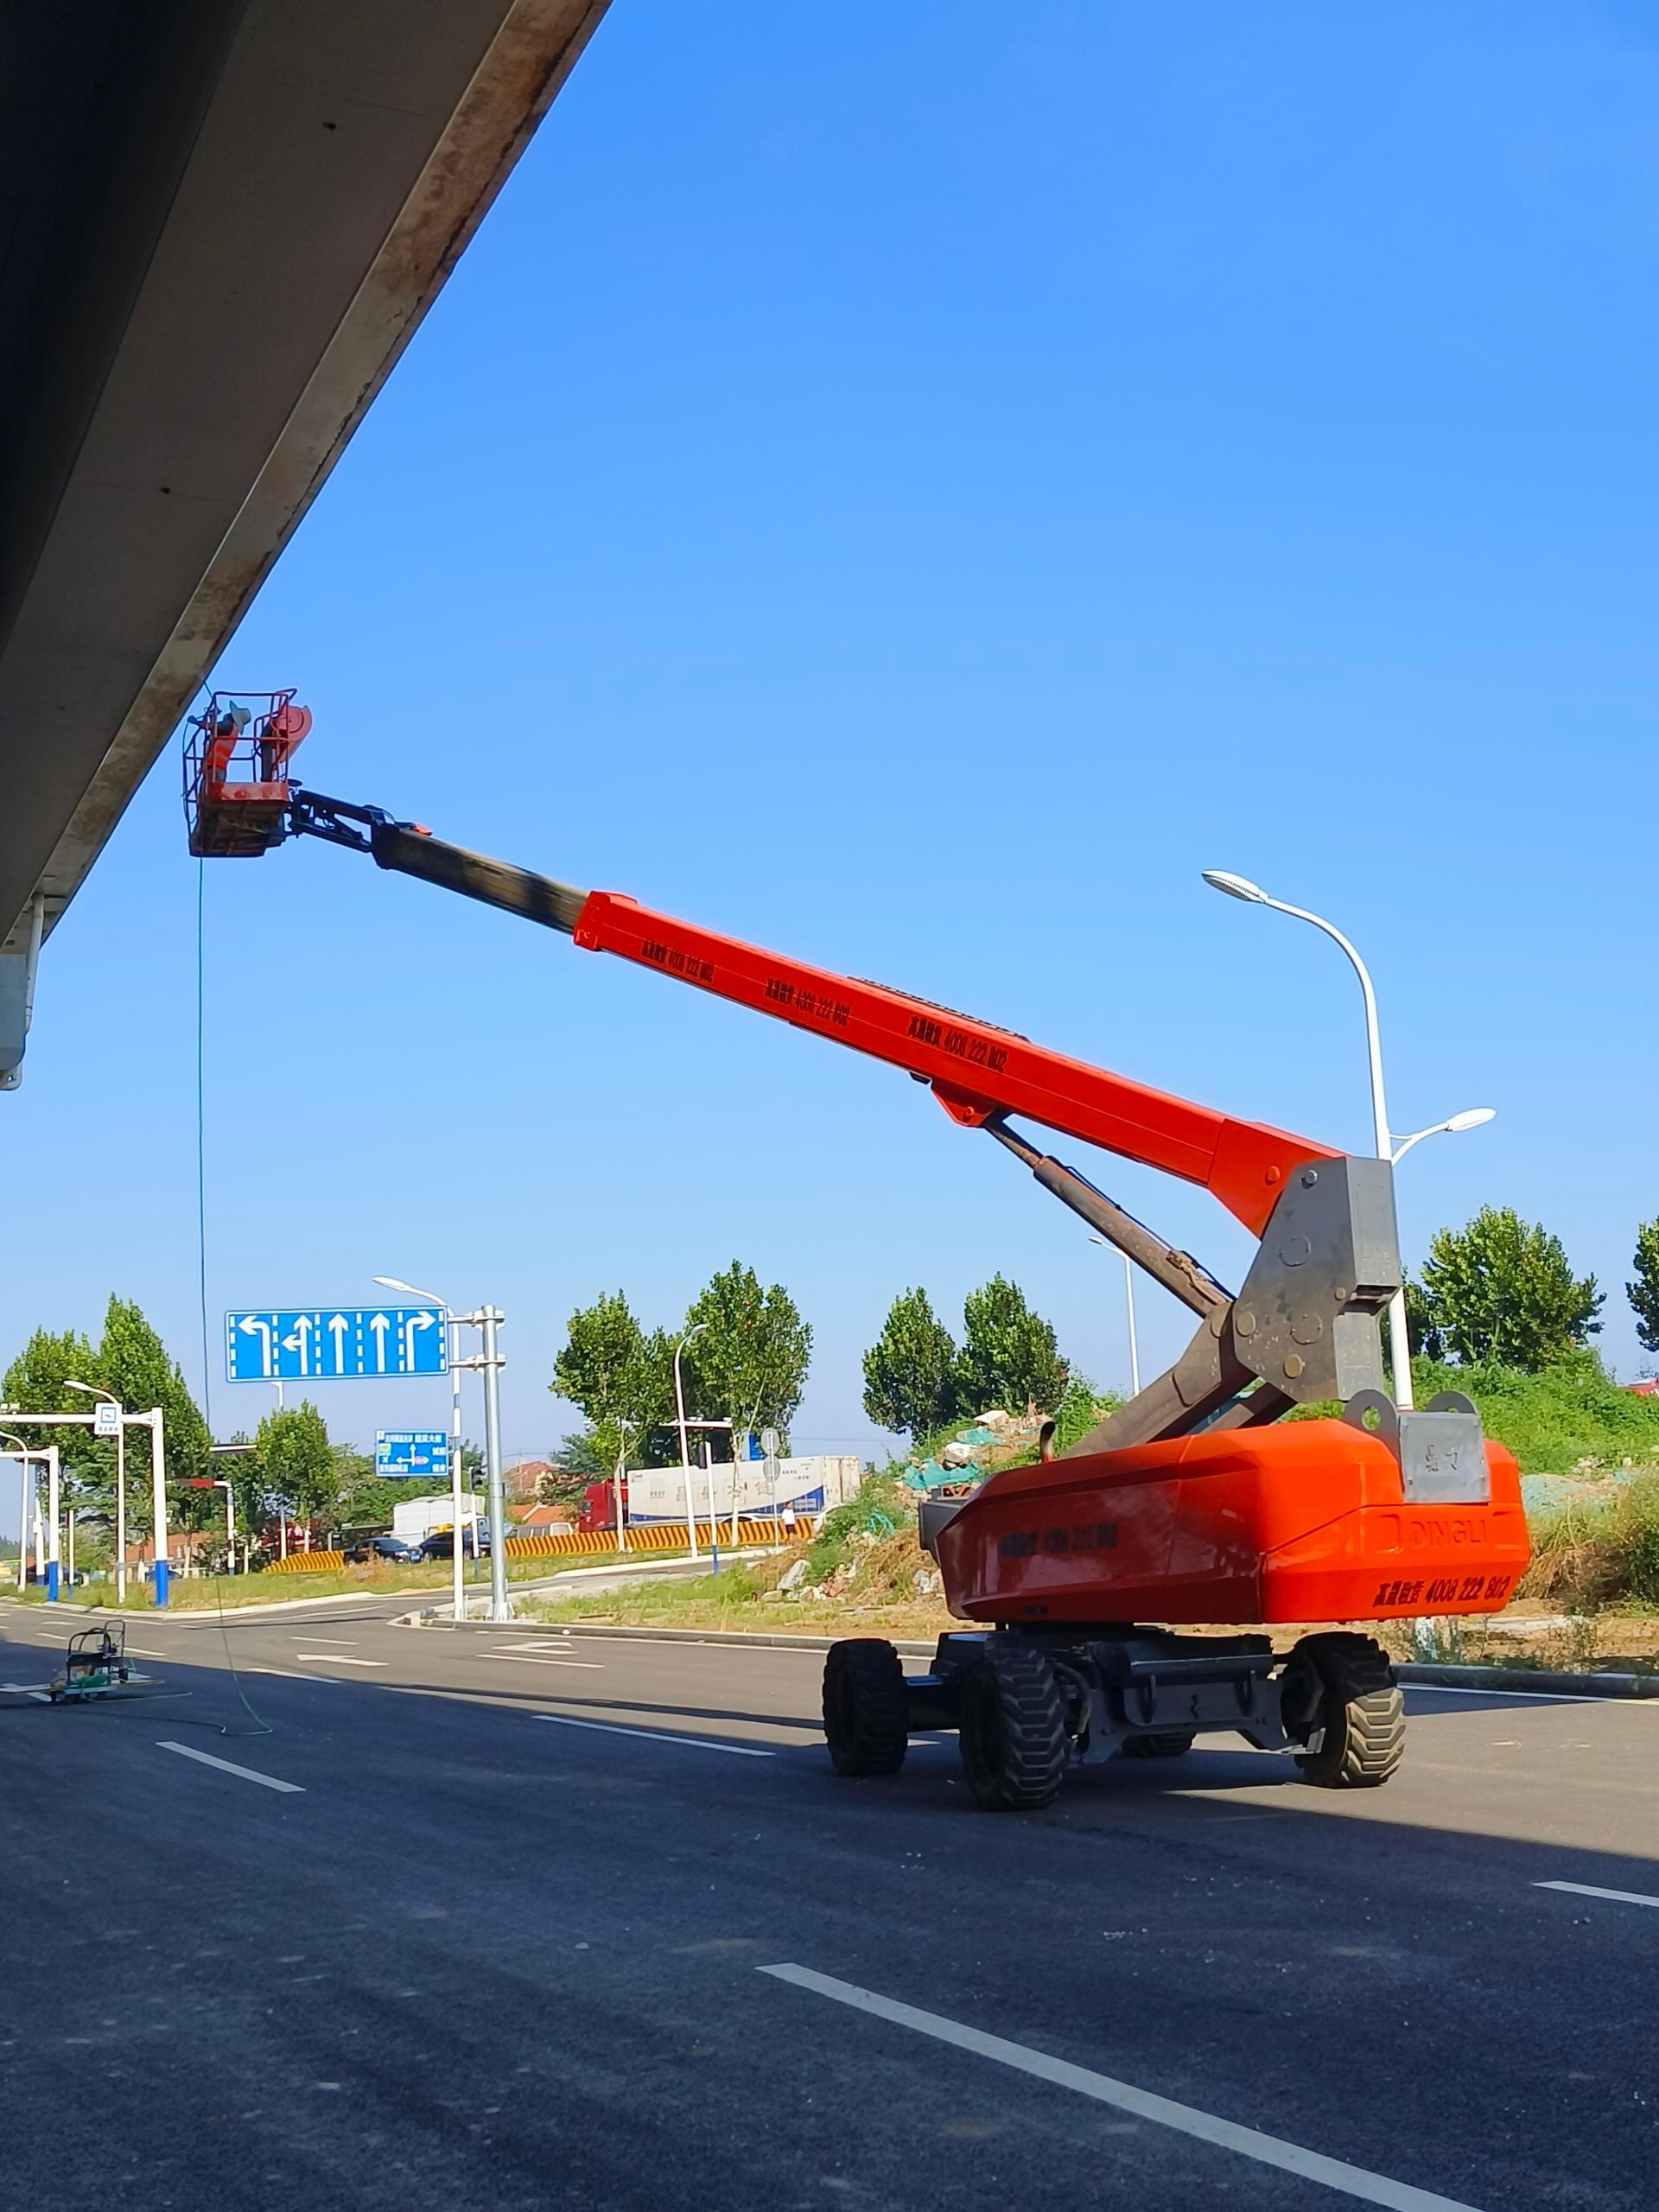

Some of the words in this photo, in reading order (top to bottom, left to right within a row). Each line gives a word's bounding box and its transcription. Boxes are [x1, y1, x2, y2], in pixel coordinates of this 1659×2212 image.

[967, 1038, 988, 1065] 222
[1410, 1519, 1487, 1549] DINGLI
[1425, 1579, 1459, 1603] 4008
[1458, 1575, 1485, 1601] 222
